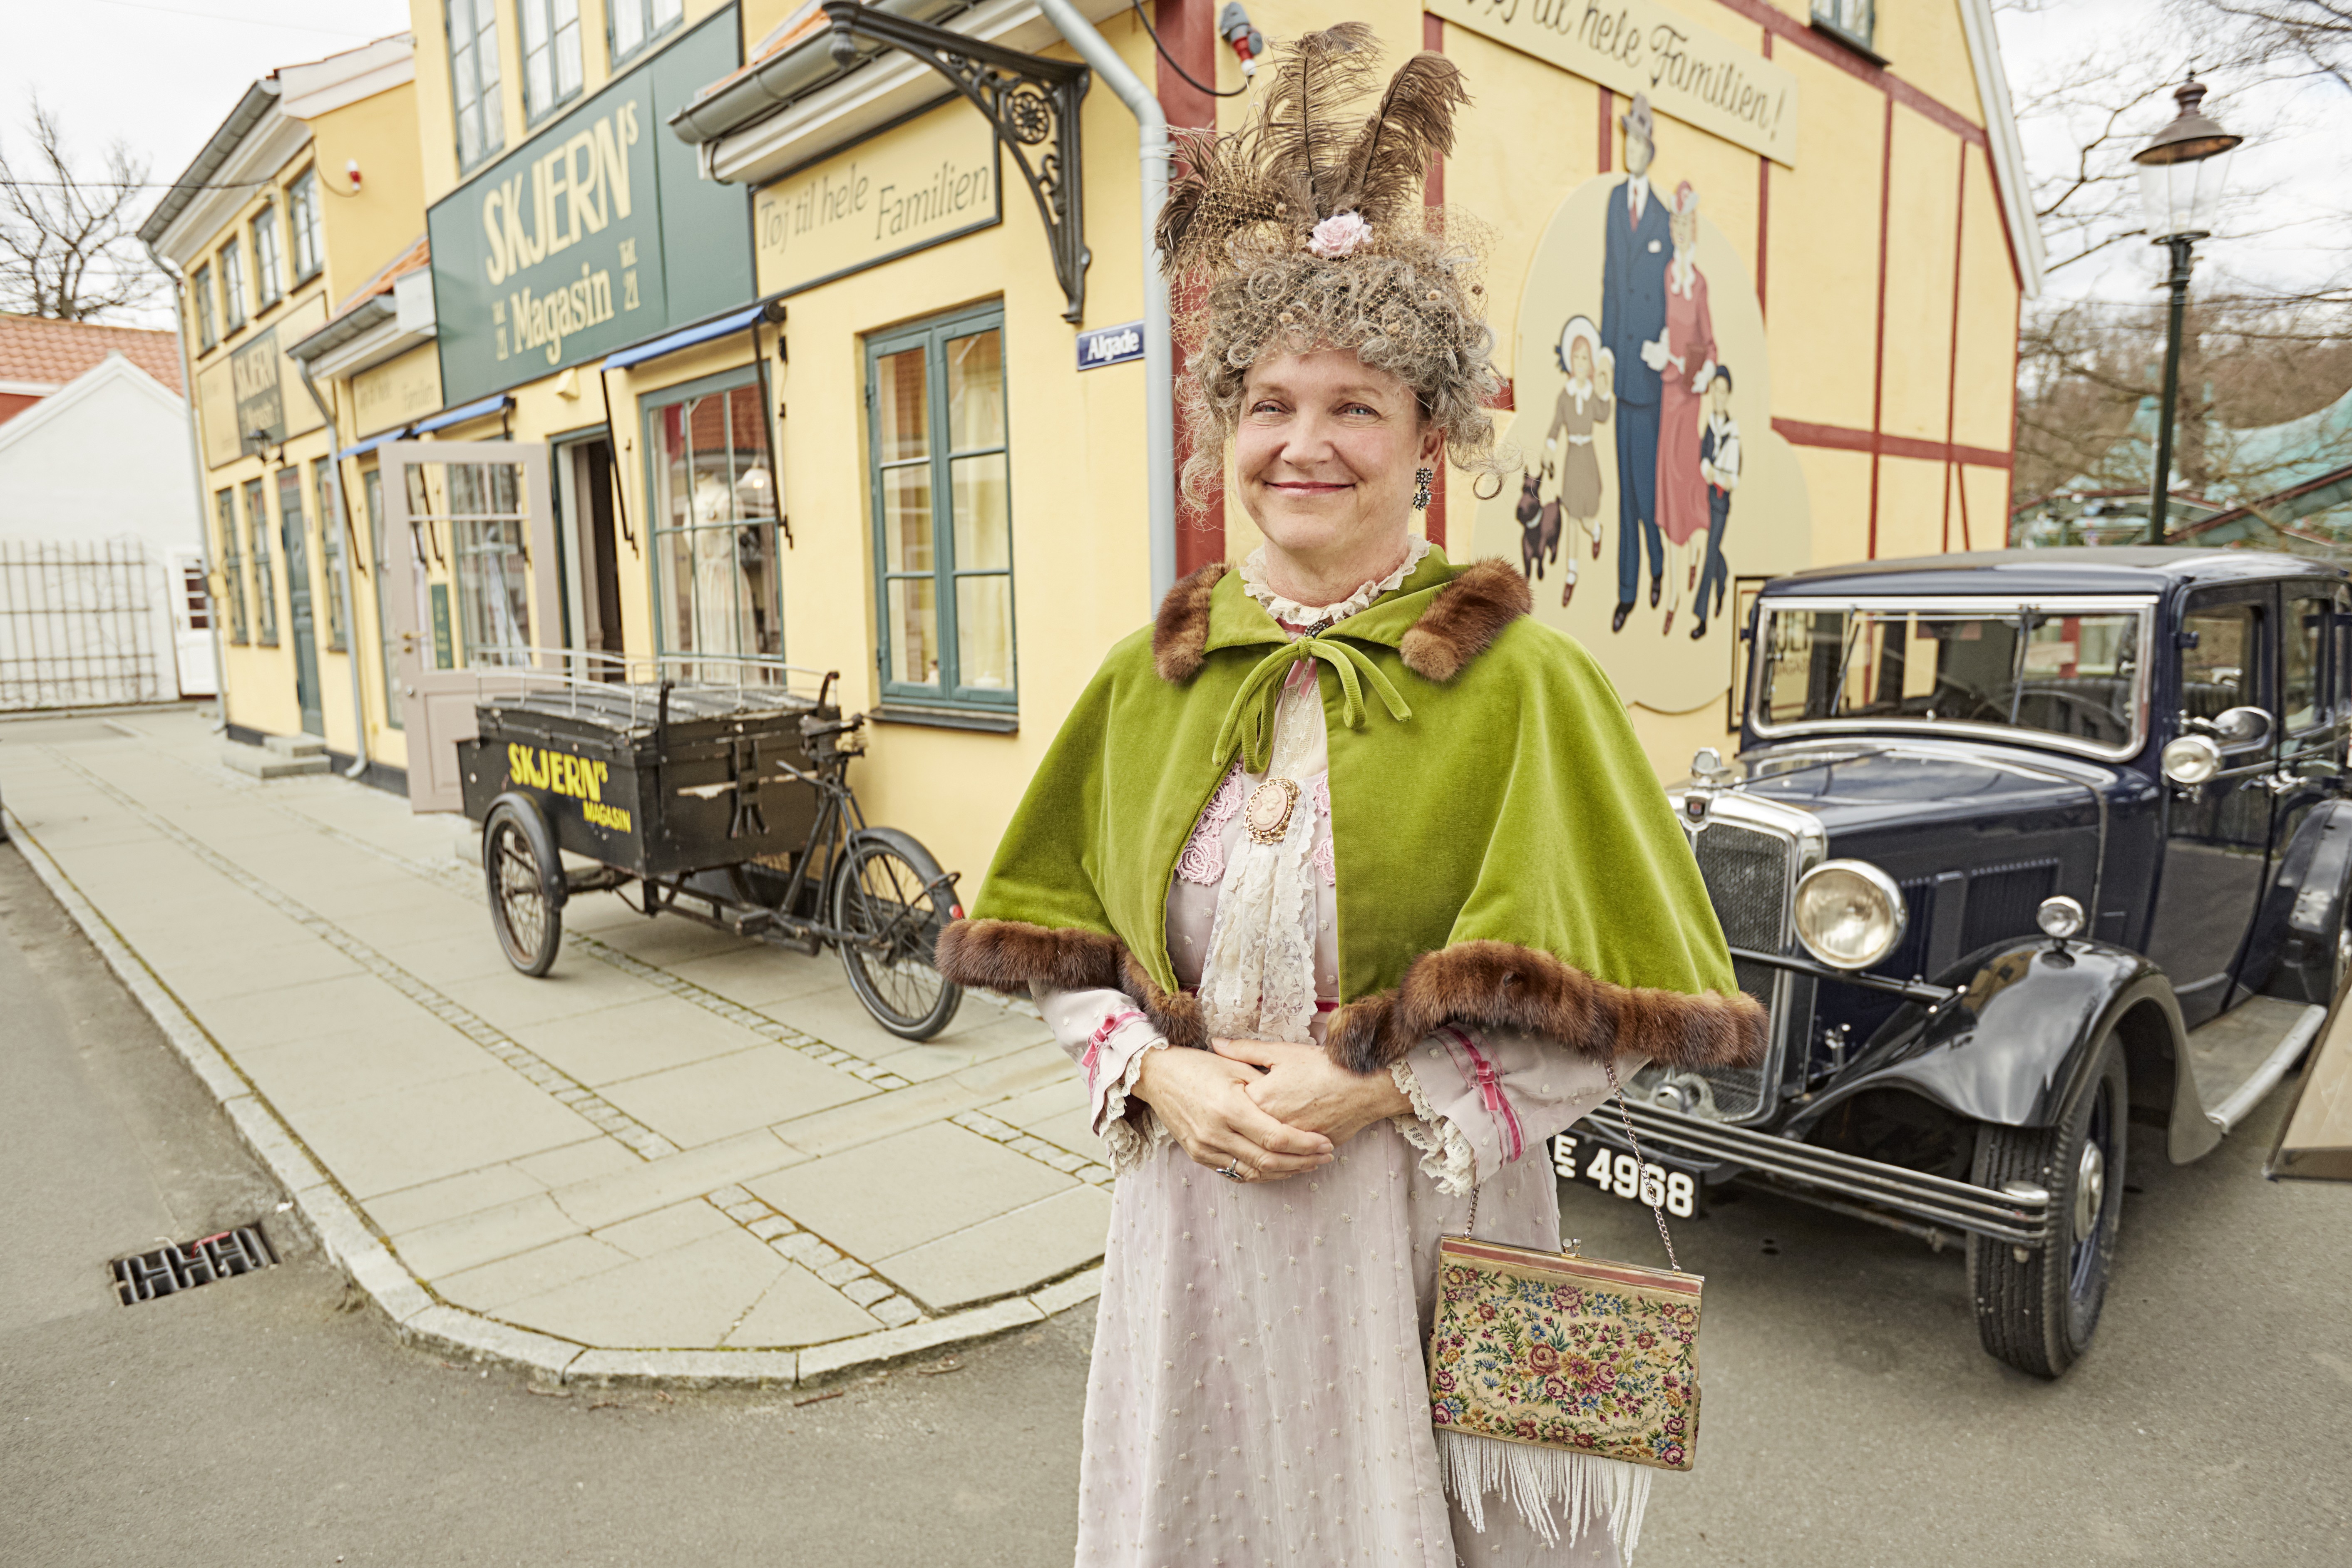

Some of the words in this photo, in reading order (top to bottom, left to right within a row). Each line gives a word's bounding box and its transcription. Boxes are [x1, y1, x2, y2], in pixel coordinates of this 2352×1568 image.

[761, 200, 790, 255] Tøj
[795, 181, 816, 236] til
[820, 161, 869, 227] hele
[874, 160, 989, 241] Familien
[509, 260, 615, 365] Magasin
[1087, 328, 1140, 361] Algade
[583, 799, 632, 834] MAGASIN
[1586, 1147, 1694, 1218] 4968
